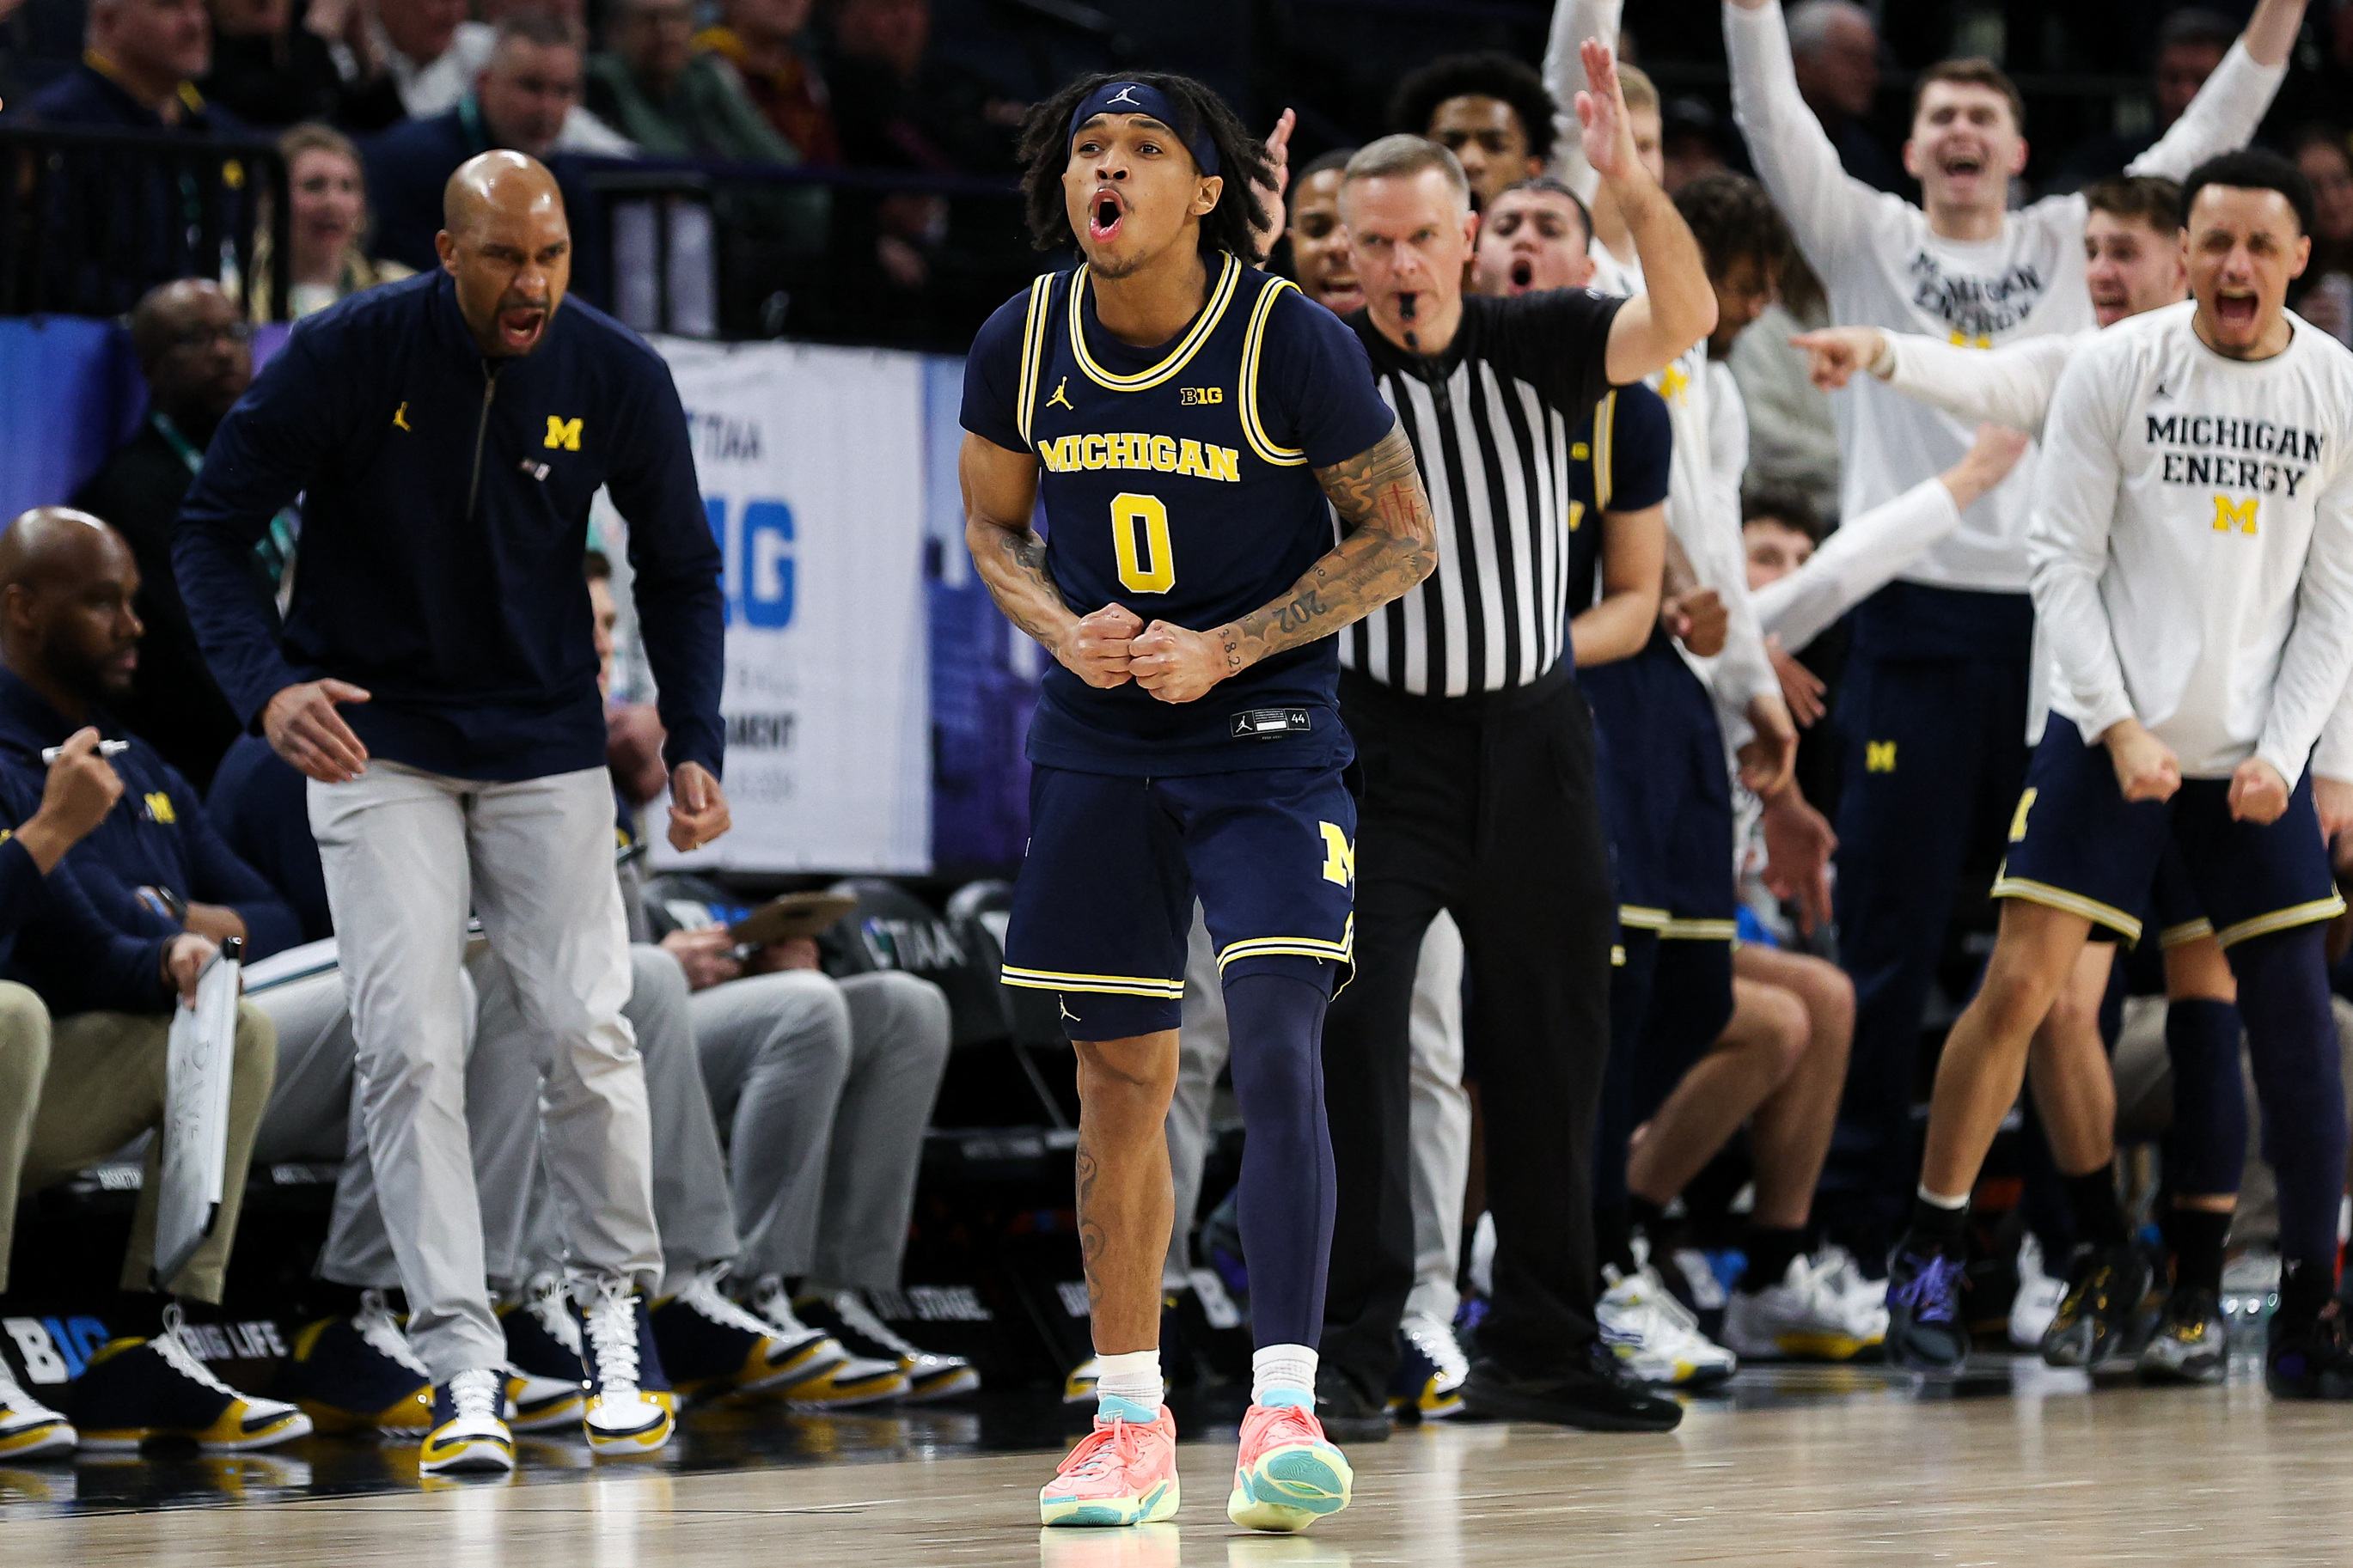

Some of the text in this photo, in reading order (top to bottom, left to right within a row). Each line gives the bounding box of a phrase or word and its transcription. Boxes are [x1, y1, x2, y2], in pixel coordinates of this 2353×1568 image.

[543, 414, 584, 452] M
[2146, 414, 2324, 462] MICHIGAN
[1037, 432, 1240, 482] MICHIGAN
[2162, 451, 2305, 497] ENERGY
[2211, 492, 2260, 535] M
[1109, 491, 1176, 595] 0
[1291, 713, 1305, 724] 44
[1865, 740, 1898, 773] M
